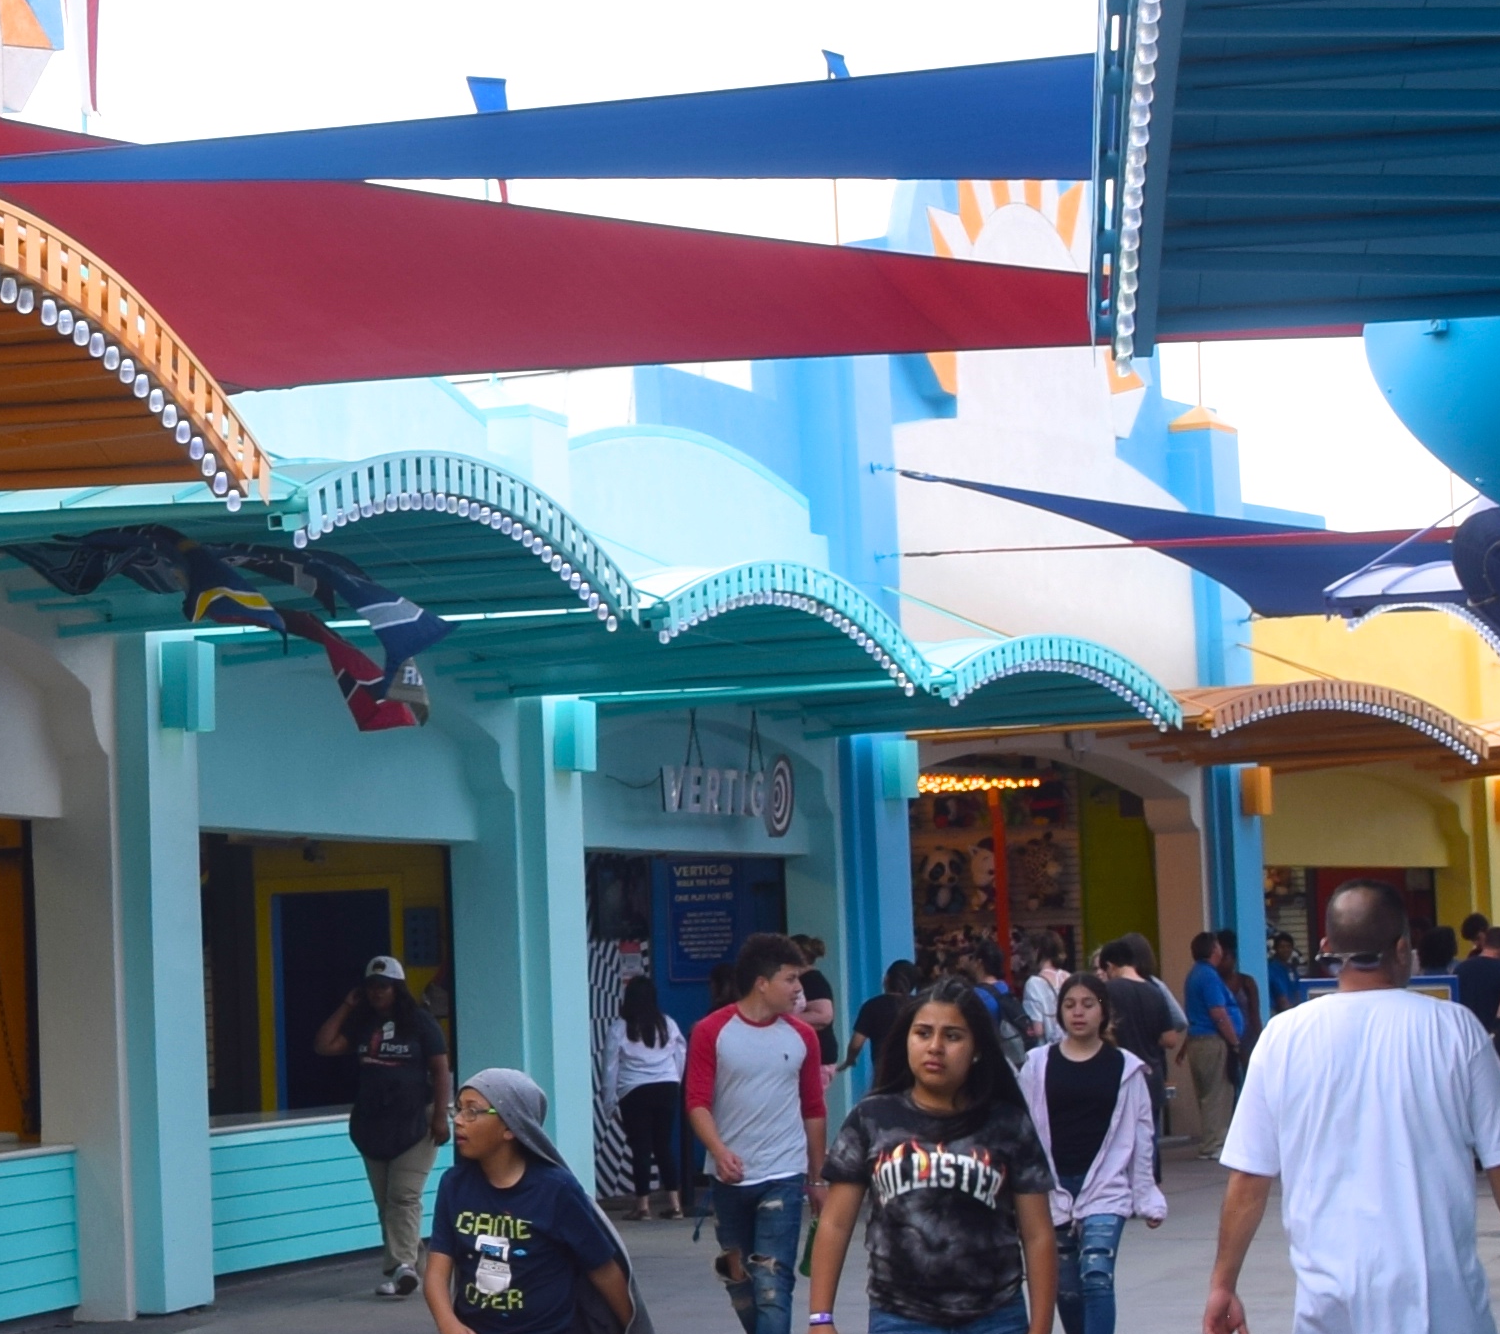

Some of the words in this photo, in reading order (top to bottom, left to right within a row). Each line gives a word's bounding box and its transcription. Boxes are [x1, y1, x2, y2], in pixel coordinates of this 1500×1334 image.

[661, 755, 794, 837] VERTIGO
[380, 1042, 409, 1054] Flags
[455, 1211, 533, 1240] GAME
